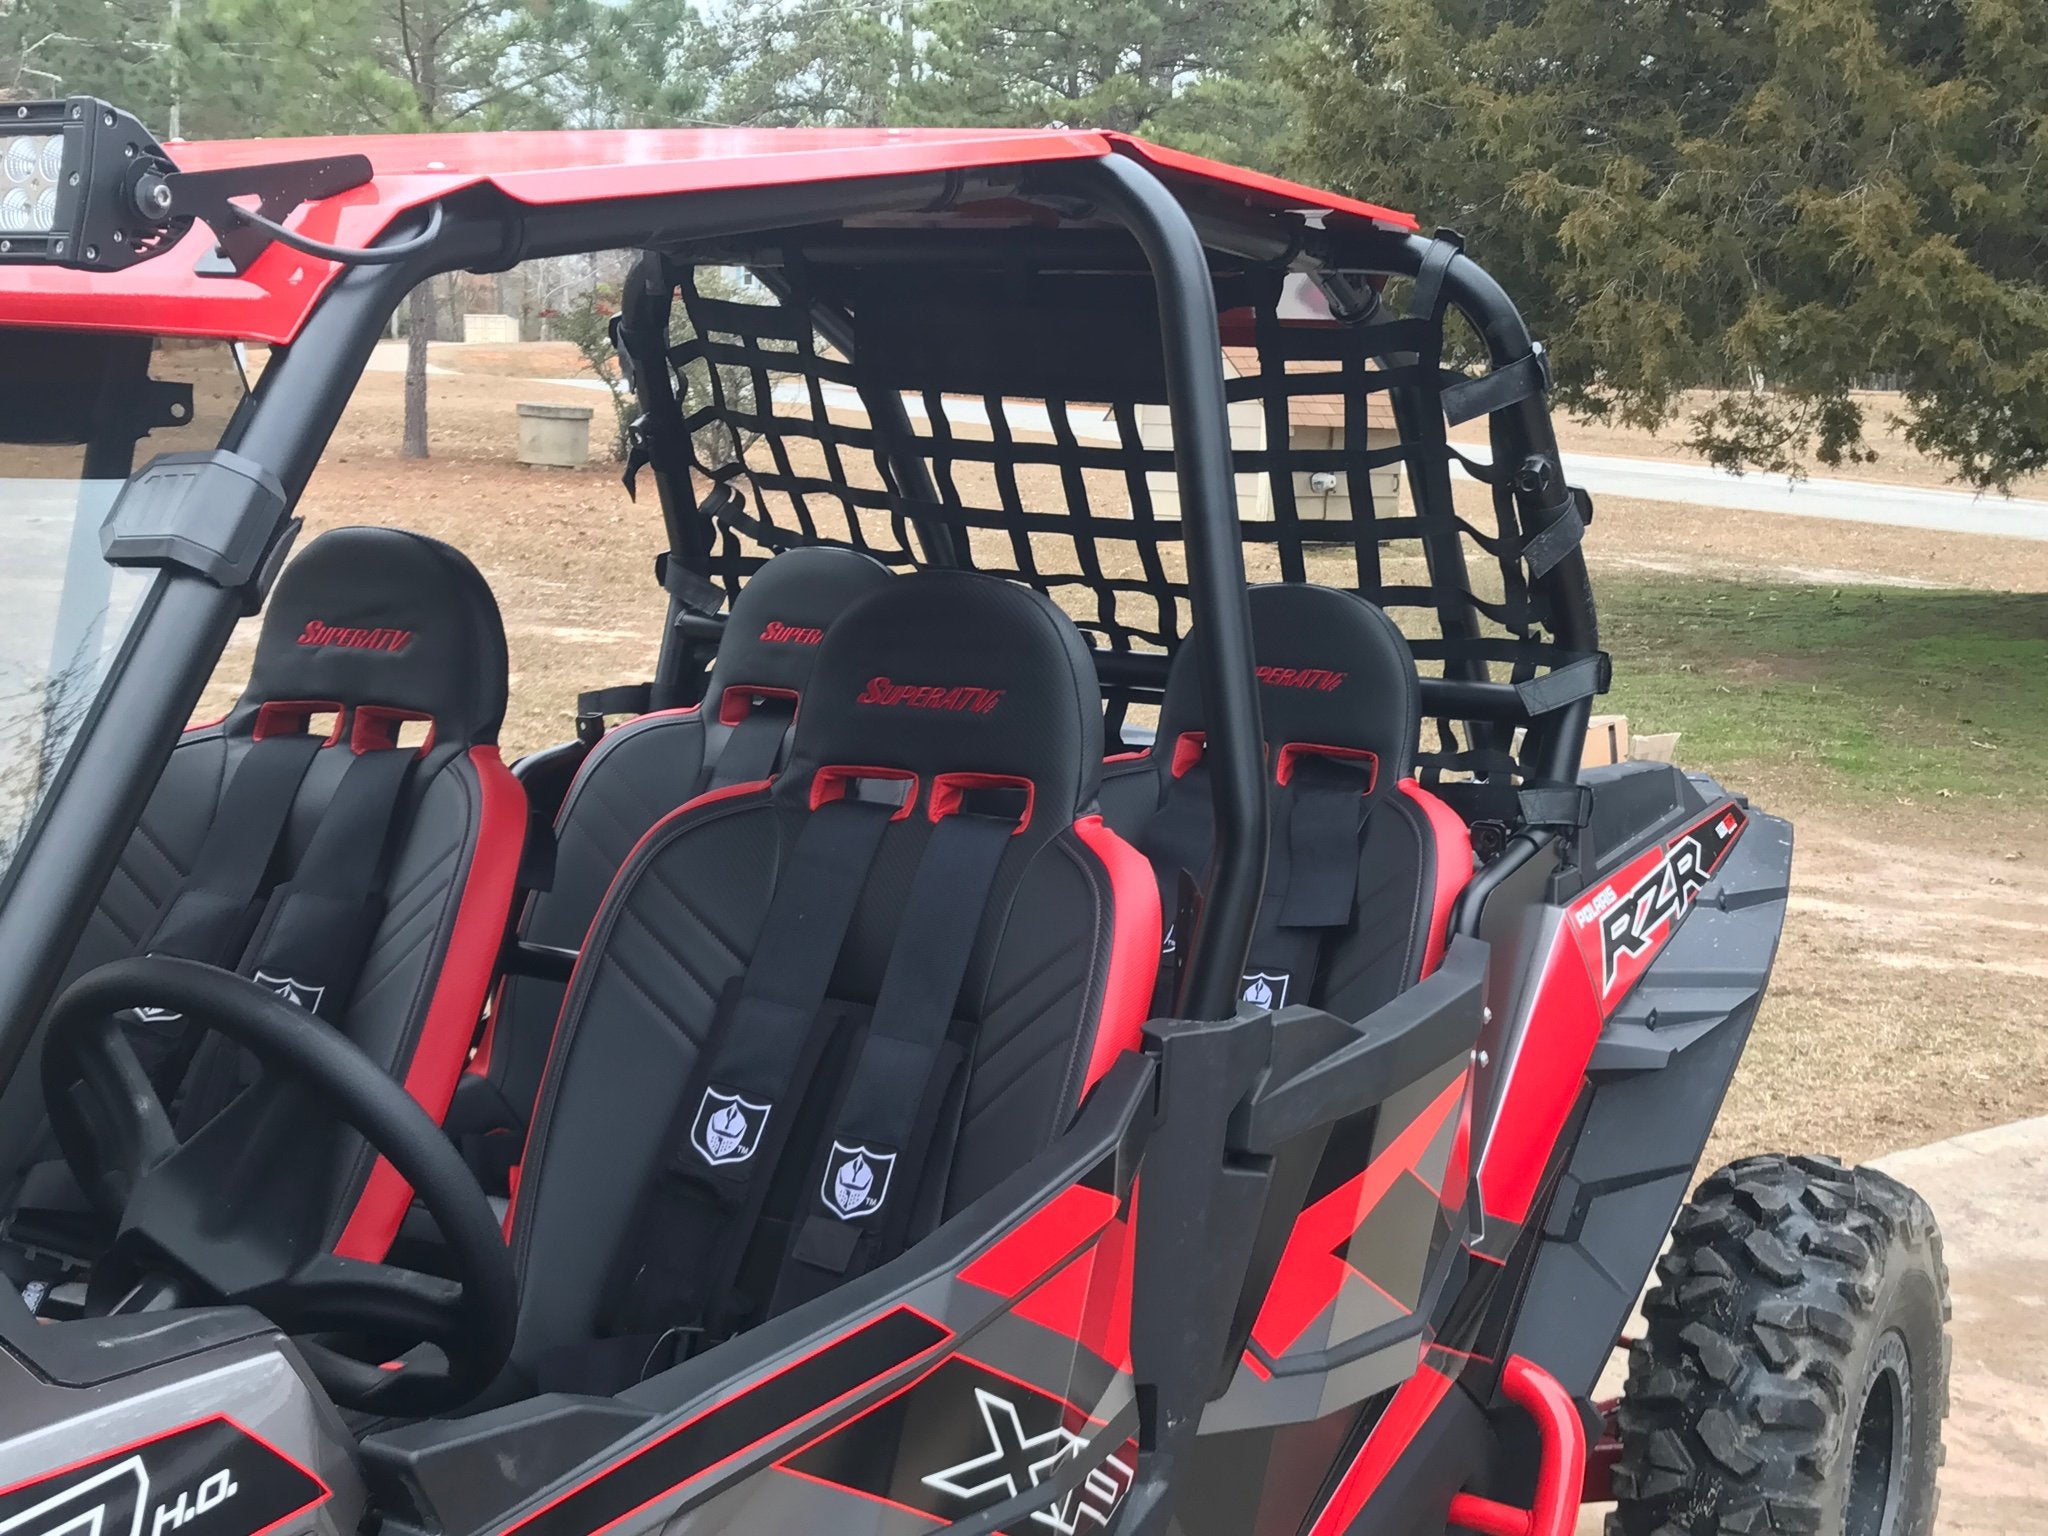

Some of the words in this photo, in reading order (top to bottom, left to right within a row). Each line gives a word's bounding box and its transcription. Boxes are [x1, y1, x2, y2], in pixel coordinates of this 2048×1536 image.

[760, 621, 824, 645] SUPER
[1256, 665, 1347, 691] PERATV
[1575, 884, 1618, 929] POLARIS
[1600, 835, 1710, 1000] RZR
[151, 1468, 238, 1536] H.O.
